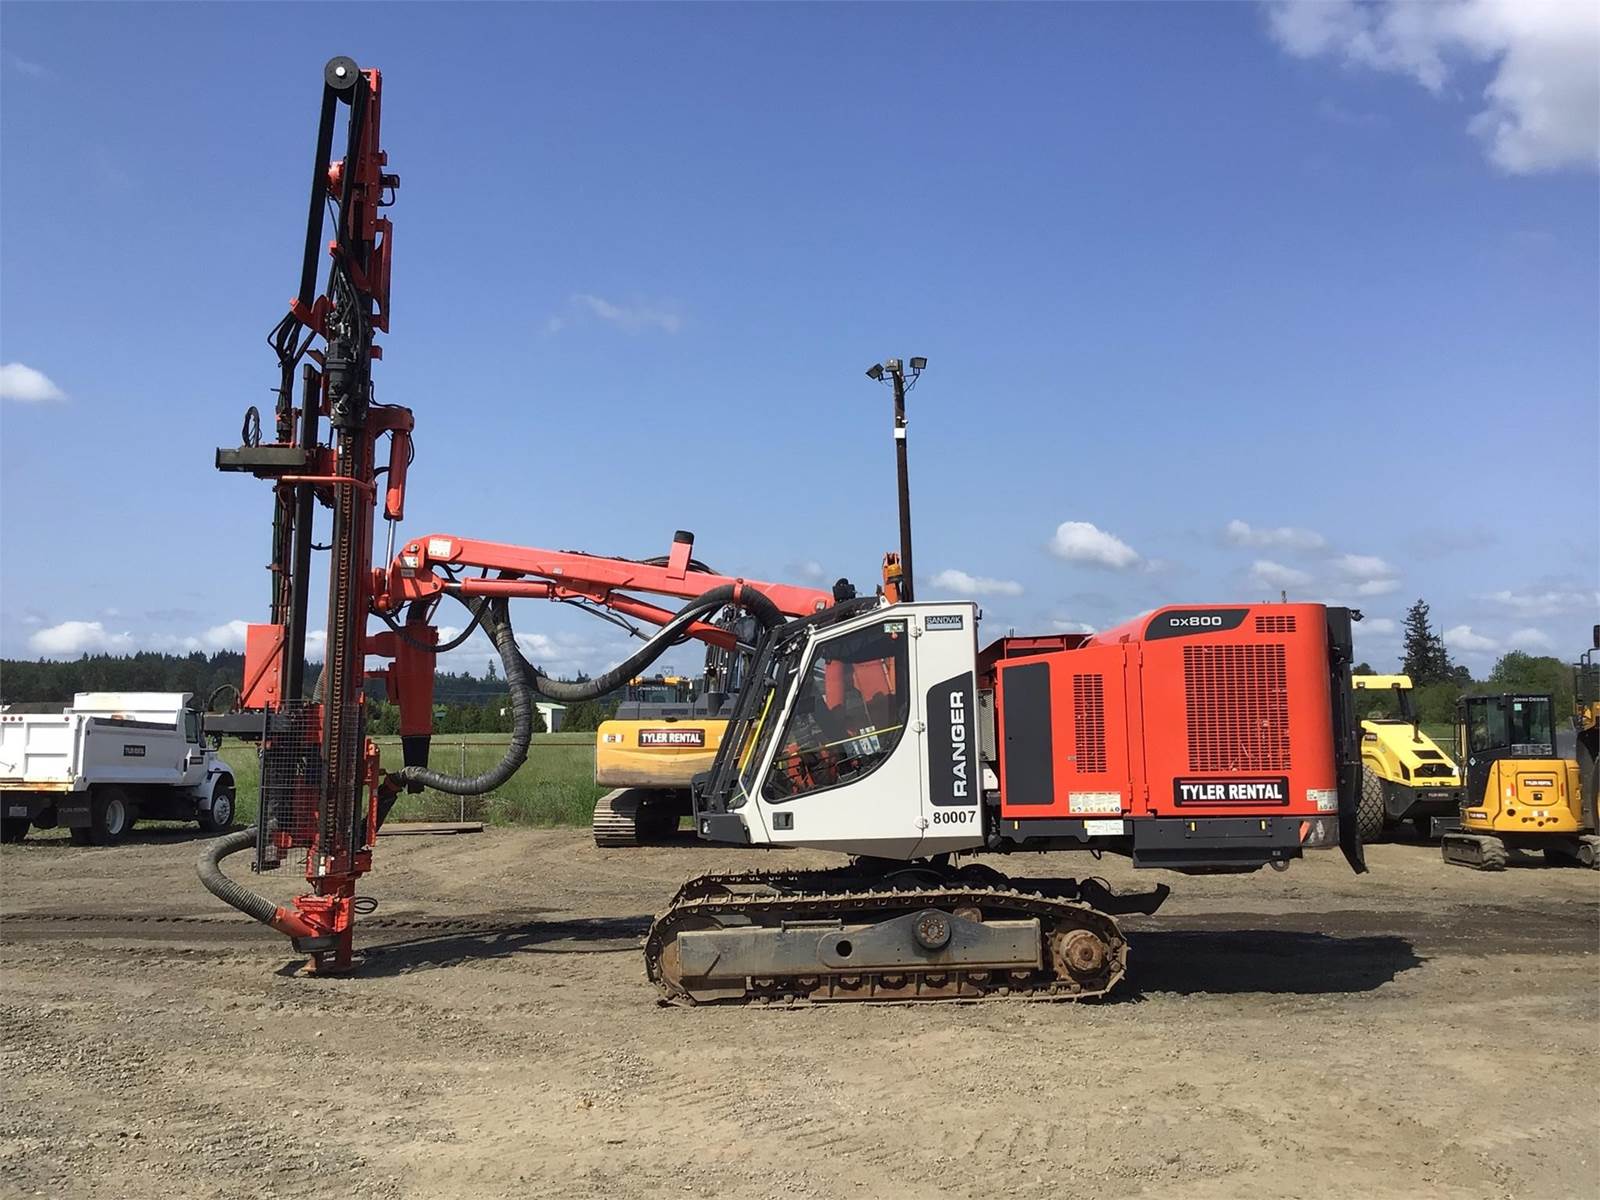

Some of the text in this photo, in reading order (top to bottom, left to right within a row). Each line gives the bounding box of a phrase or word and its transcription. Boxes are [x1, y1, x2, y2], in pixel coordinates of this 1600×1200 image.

[926, 616, 961, 625] SANDVIK
[1169, 616, 1222, 626] DX800
[642, 733, 701, 743] TYLER RENTAL
[949, 691, 968, 797] RANGER
[1180, 783, 1283, 800] TYLER RENTAL
[933, 811, 976, 824] 80007
